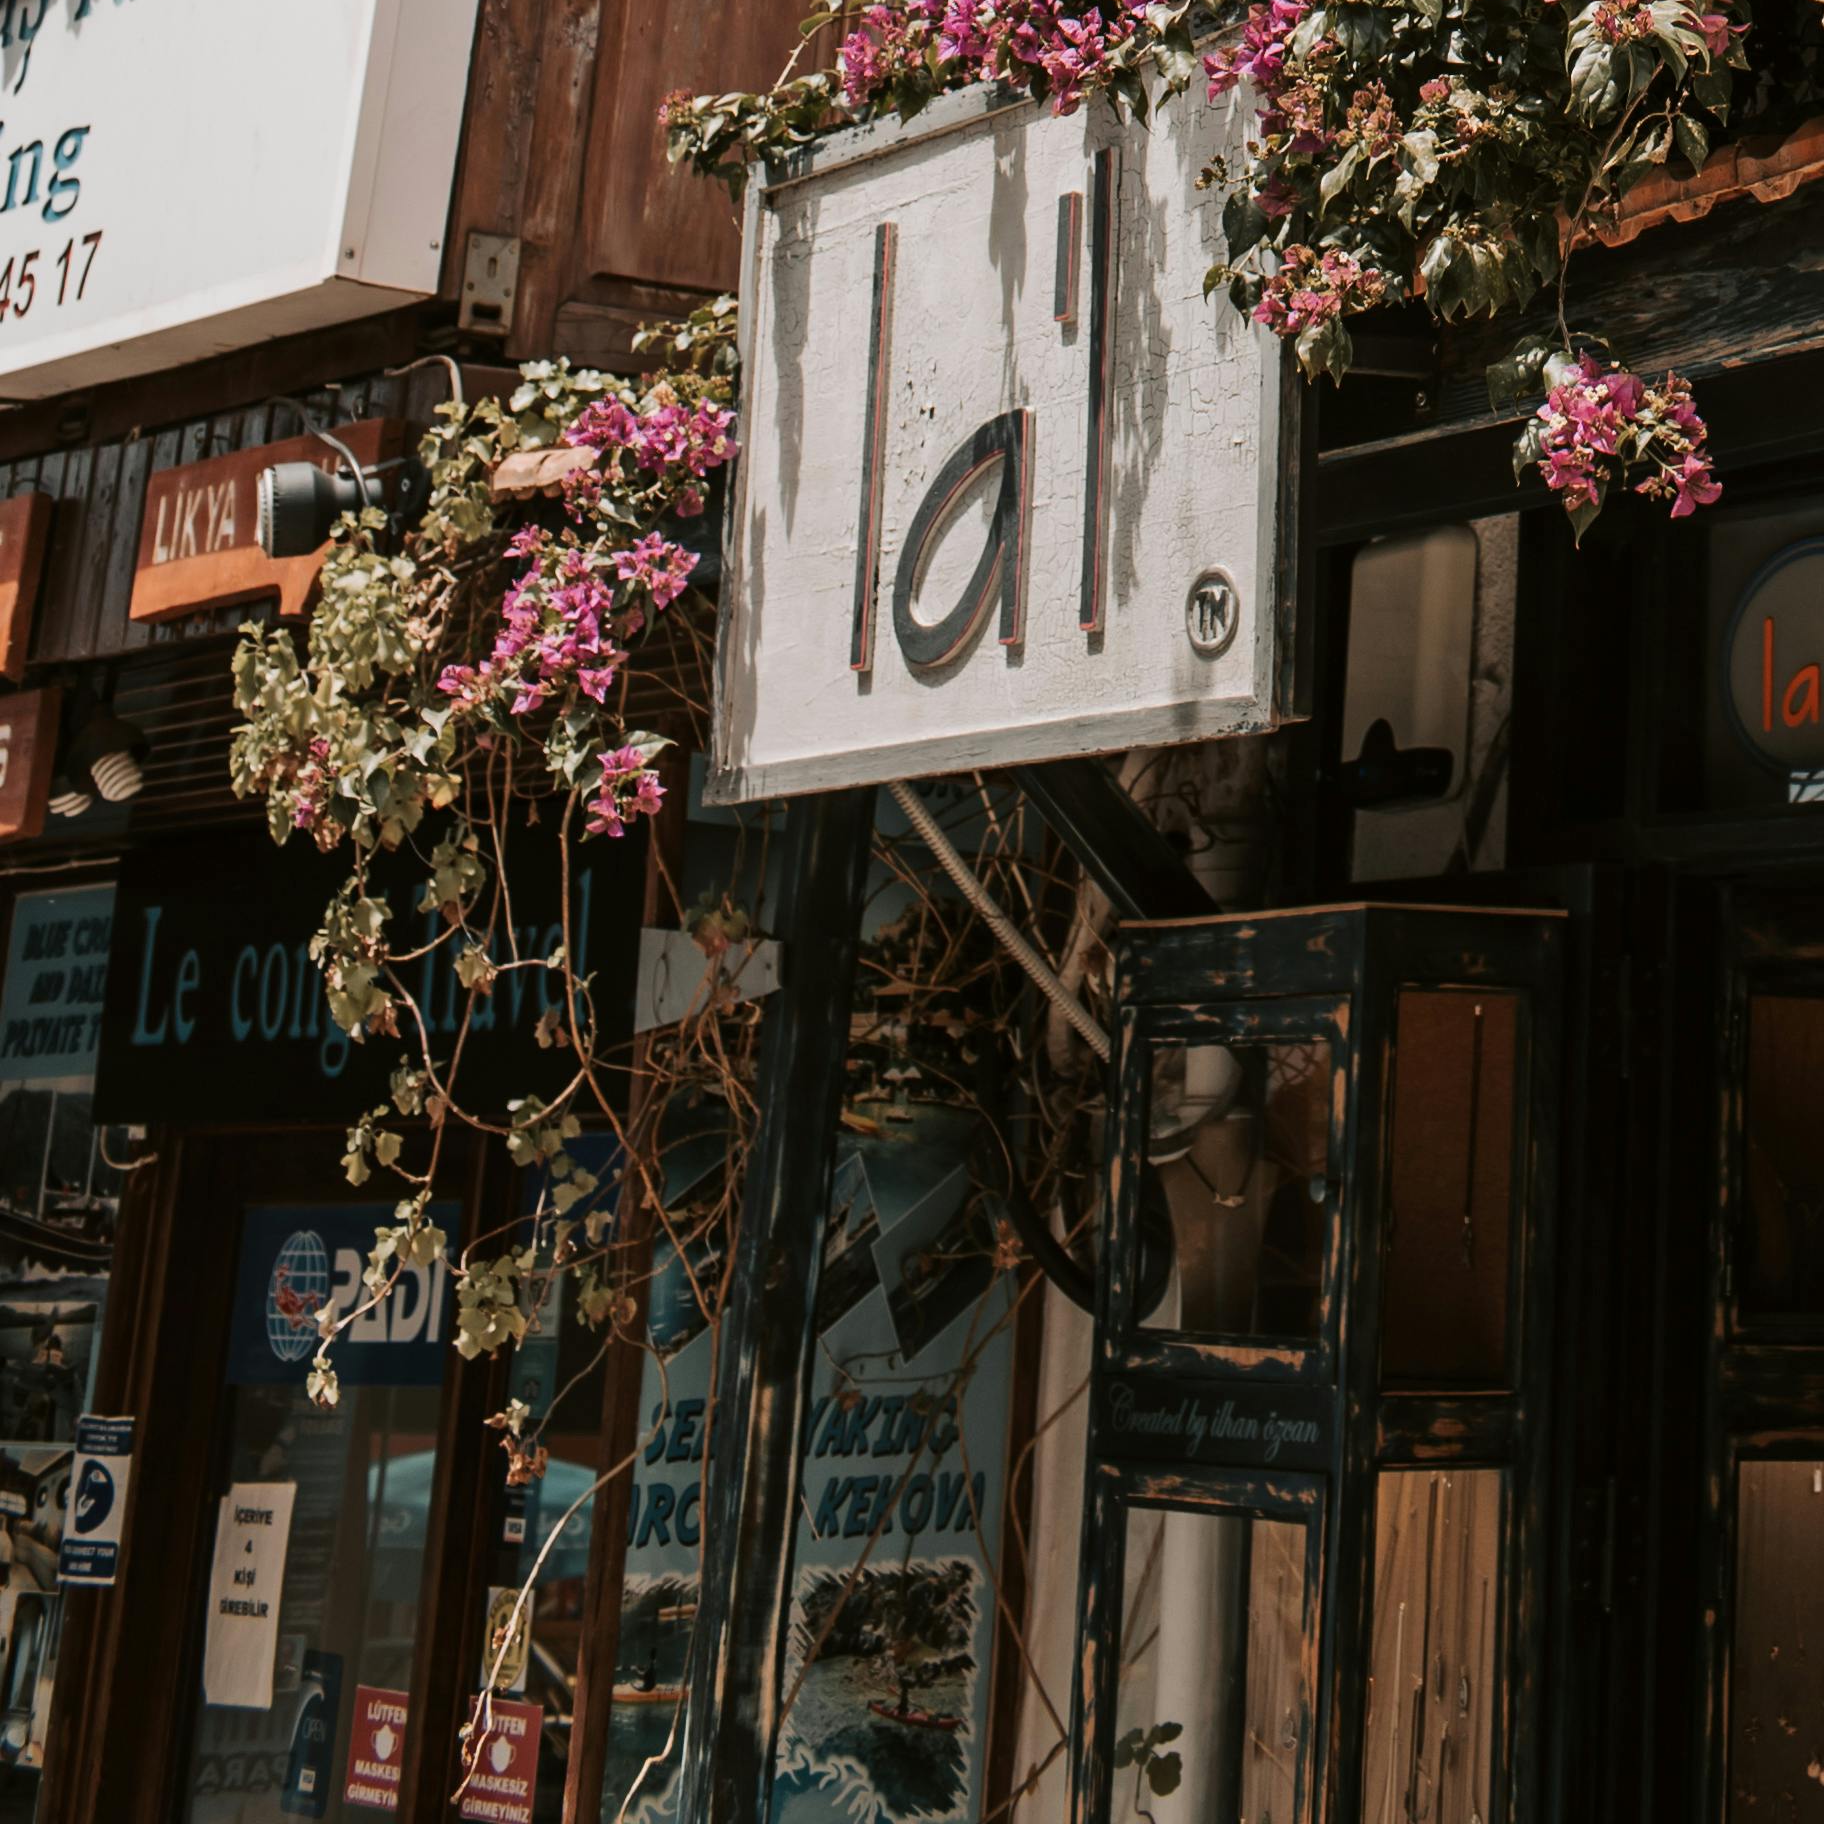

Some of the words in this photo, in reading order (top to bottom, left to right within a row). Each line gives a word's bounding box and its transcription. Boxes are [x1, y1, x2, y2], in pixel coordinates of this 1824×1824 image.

[0, 120, 91, 224] ng
[57, 229, 103, 306] 17
[152, 478, 237, 565] LİKYA
[22, 920, 73, 962] BLUE
[130, 905, 201, 1047] Le
[29, 969, 64, 1005] AND
[0, 1013, 86, 1059] PRIVATE
[331, 1246, 448, 1344] PADI
[1108, 1380, 1184, 1434] Created
[1184, 1398, 1210, 1457] by
[1211, 1400, 1260, 1441] ilhan
[1263, 1410, 1321, 1464] özcan
[812, 1471, 985, 1539] KEKOVA
[244, 1538, 253, 1555] 4
